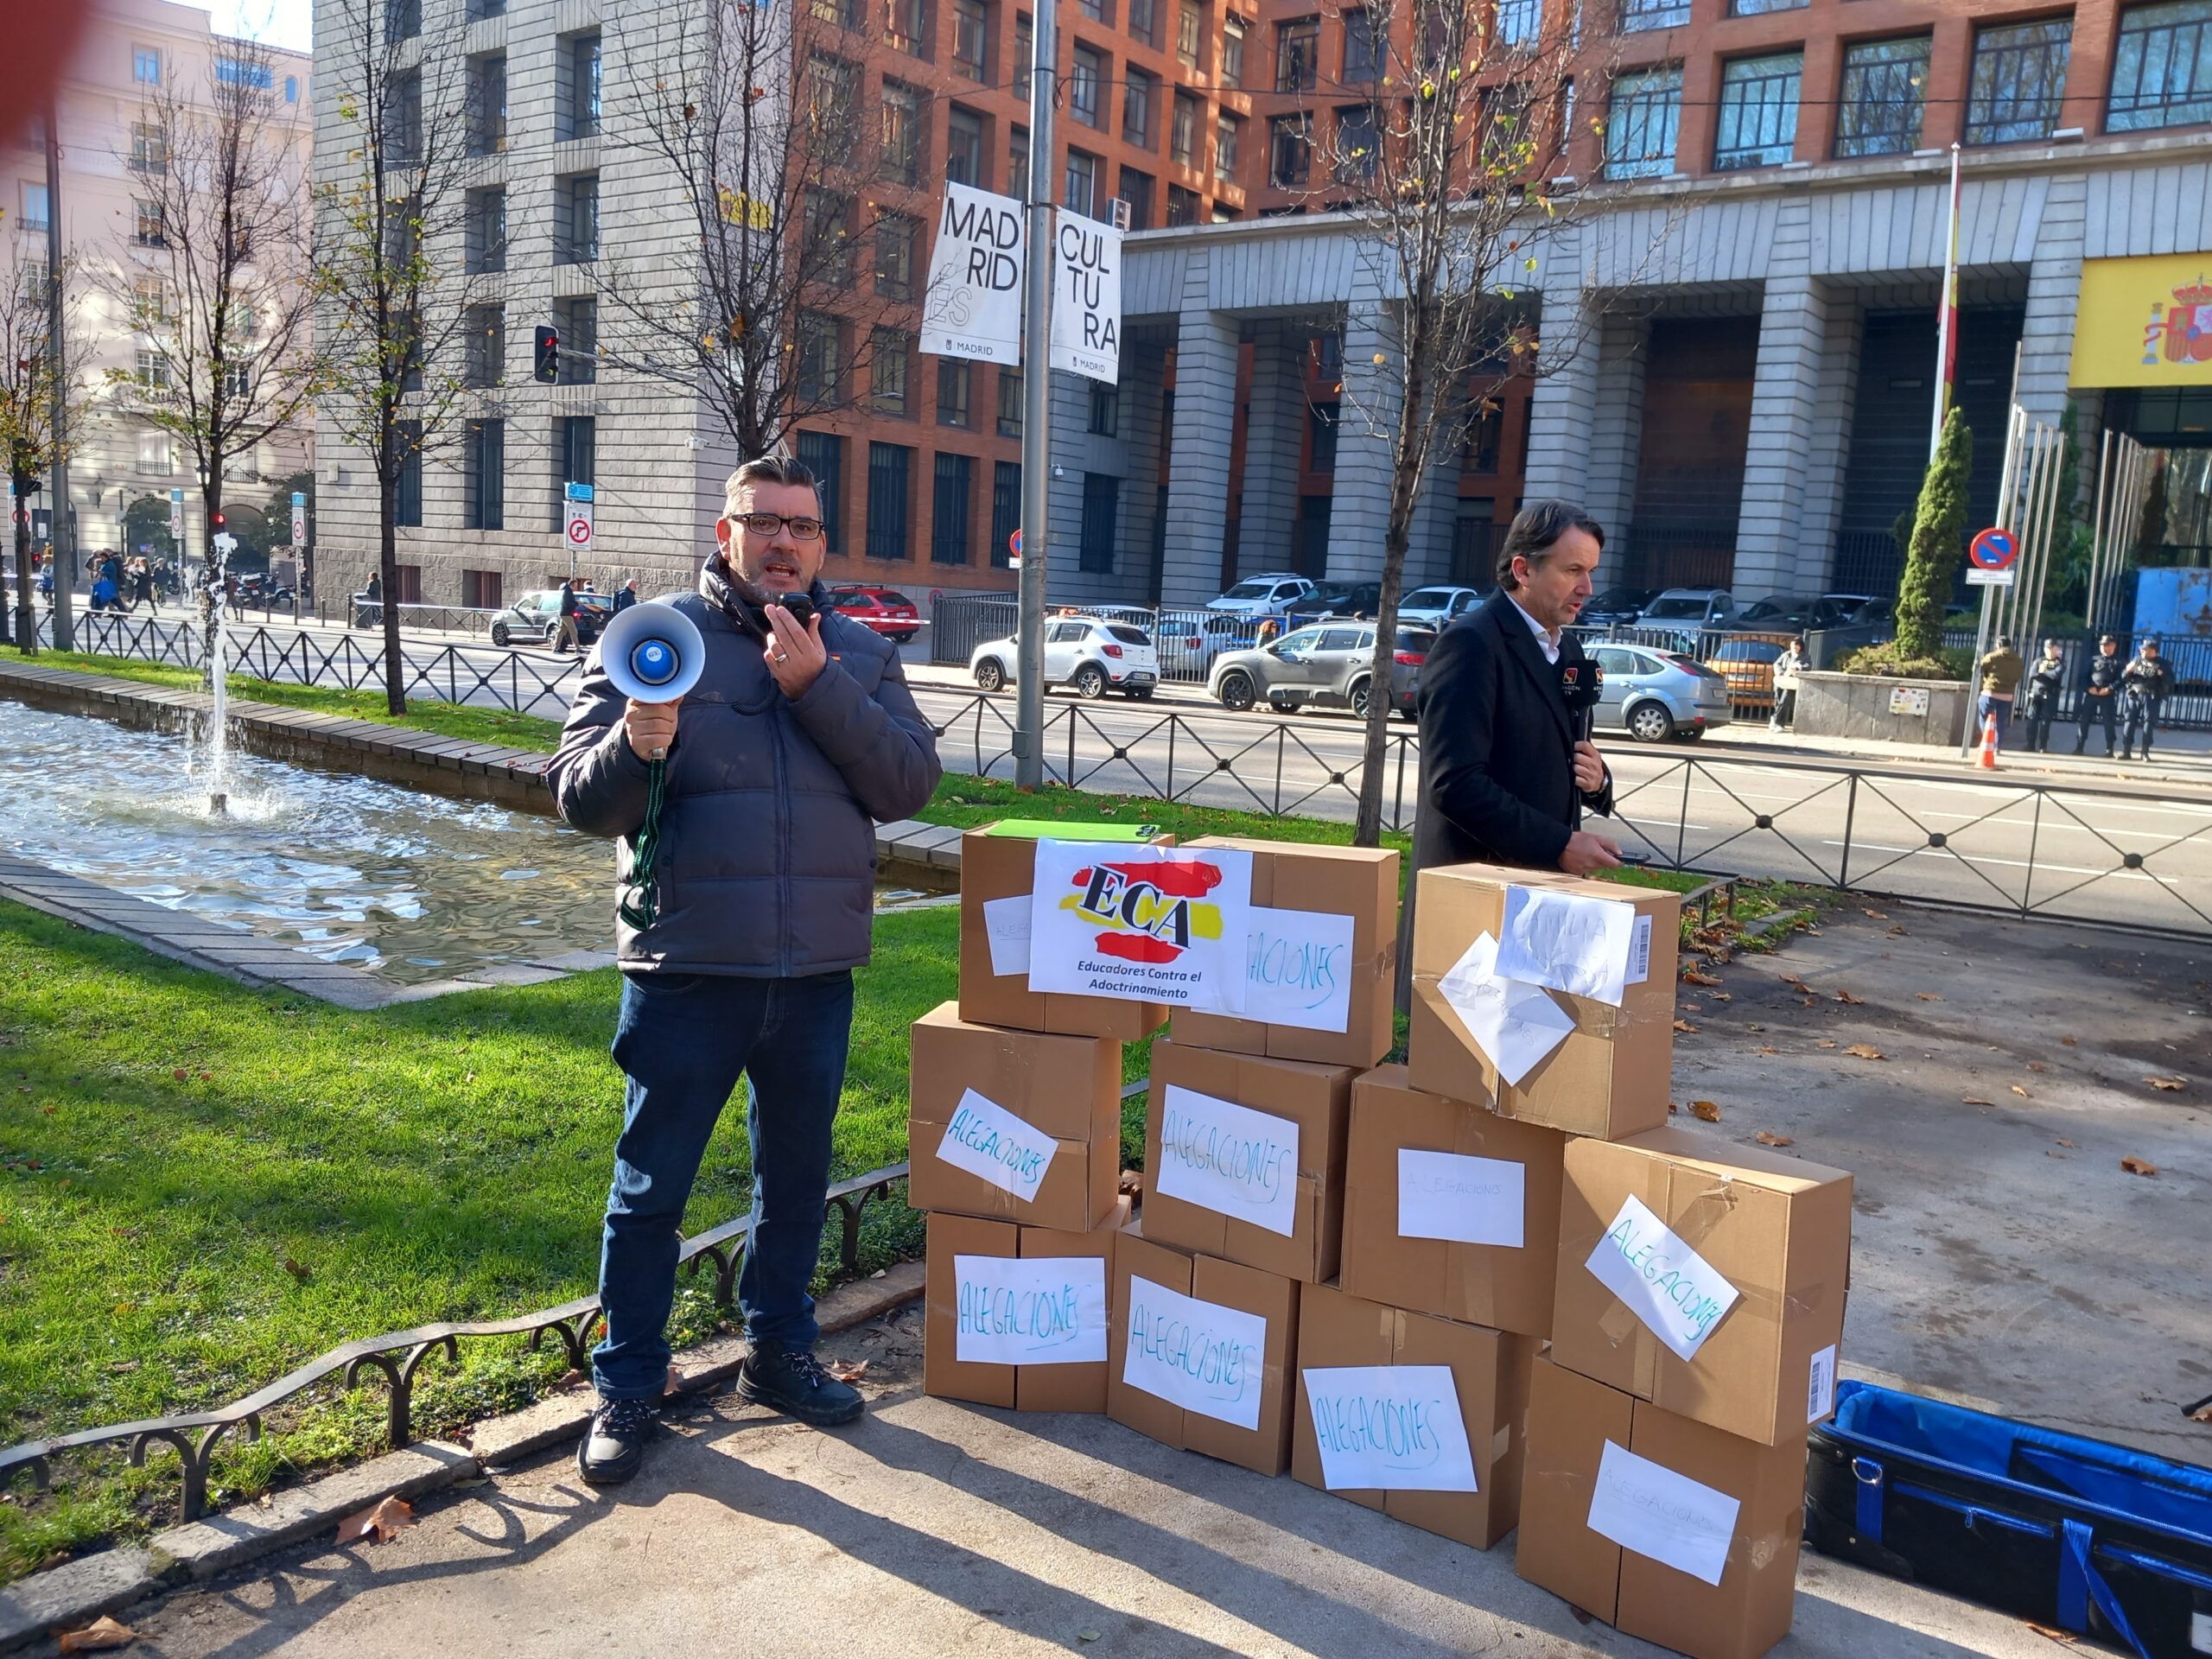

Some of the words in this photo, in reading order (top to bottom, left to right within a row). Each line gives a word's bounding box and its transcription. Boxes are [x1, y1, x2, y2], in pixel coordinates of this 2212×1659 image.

[944, 197, 1019, 251] MAD
[1060, 224, 1110, 275] CUL
[967, 247, 1018, 291] RID
[1067, 265, 1100, 310] TU
[957, 342, 994, 356] MADRID
[1084, 312, 1117, 355] RA
[1080, 359, 1106, 373] MADRID
[1079, 865, 1191, 950] ECA
[1077, 961, 1146, 976] Educadores
[1148, 968, 1187, 981] Contra
[1190, 971, 1202, 982] el
[1089, 979, 1188, 999] Adoctrinamiento
[1248, 932, 1344, 1009] ACIONES
[948, 1109, 1046, 1184] ALEGACIONES
[1164, 1109, 1292, 1204] ALEGACIONES
[960, 1281, 1091, 1351] ALEGACIONES
[1132, 1304, 1256, 1402] ALEGACIONES
[1316, 1395, 1441, 1470] ALEGACIONES
